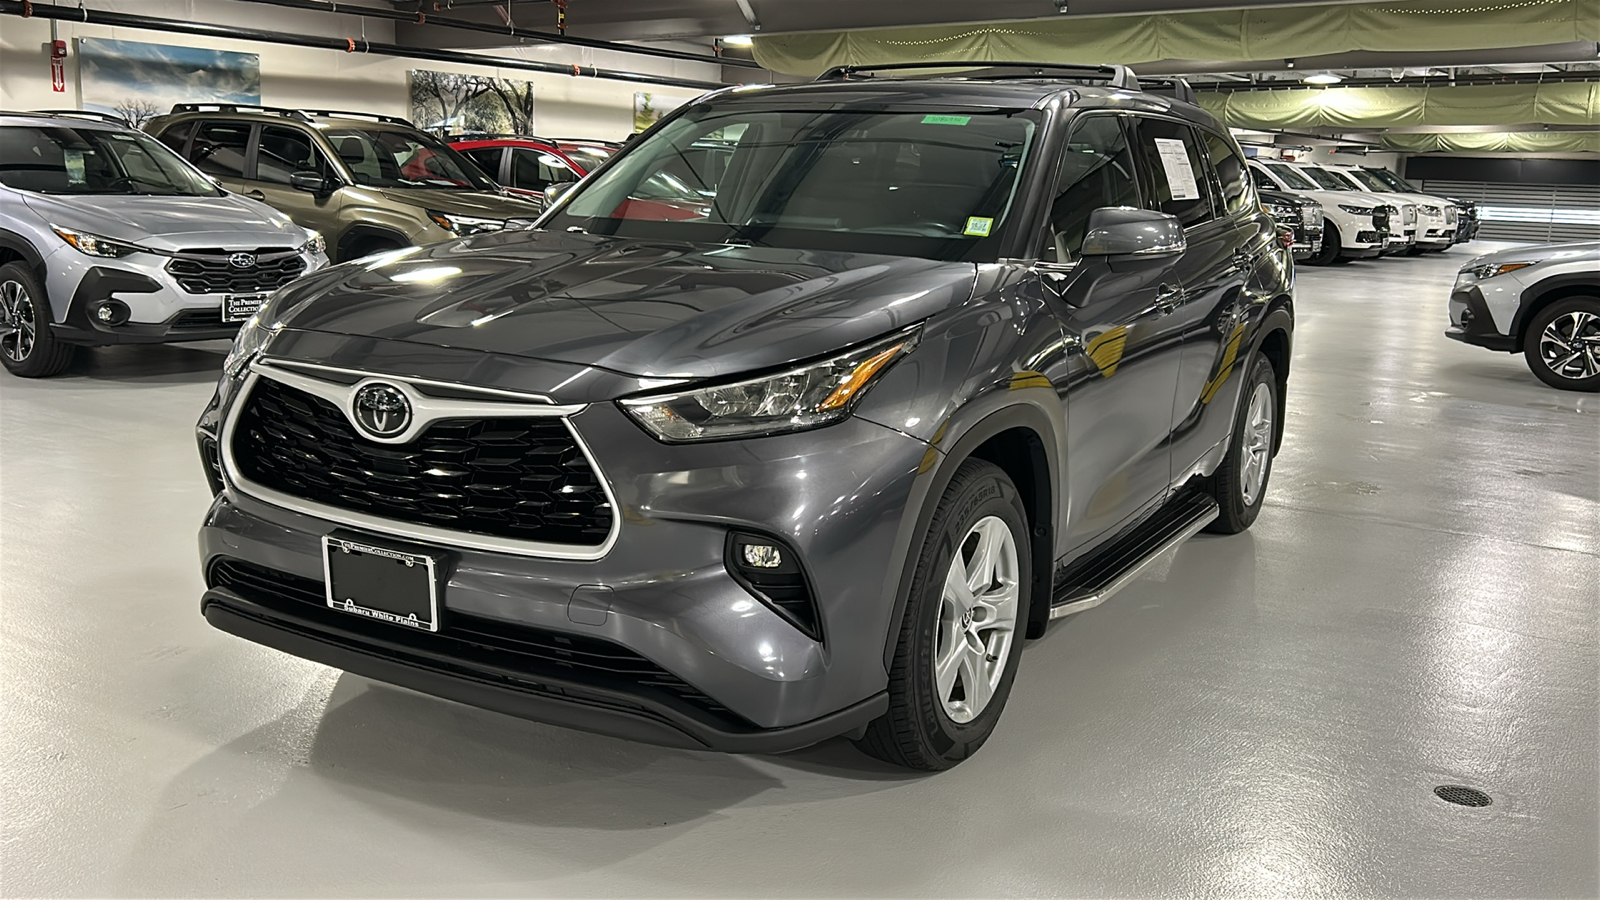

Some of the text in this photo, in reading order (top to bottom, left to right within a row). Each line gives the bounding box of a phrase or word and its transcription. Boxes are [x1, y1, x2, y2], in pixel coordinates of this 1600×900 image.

[343, 604, 420, 627] Subaru White Plains
